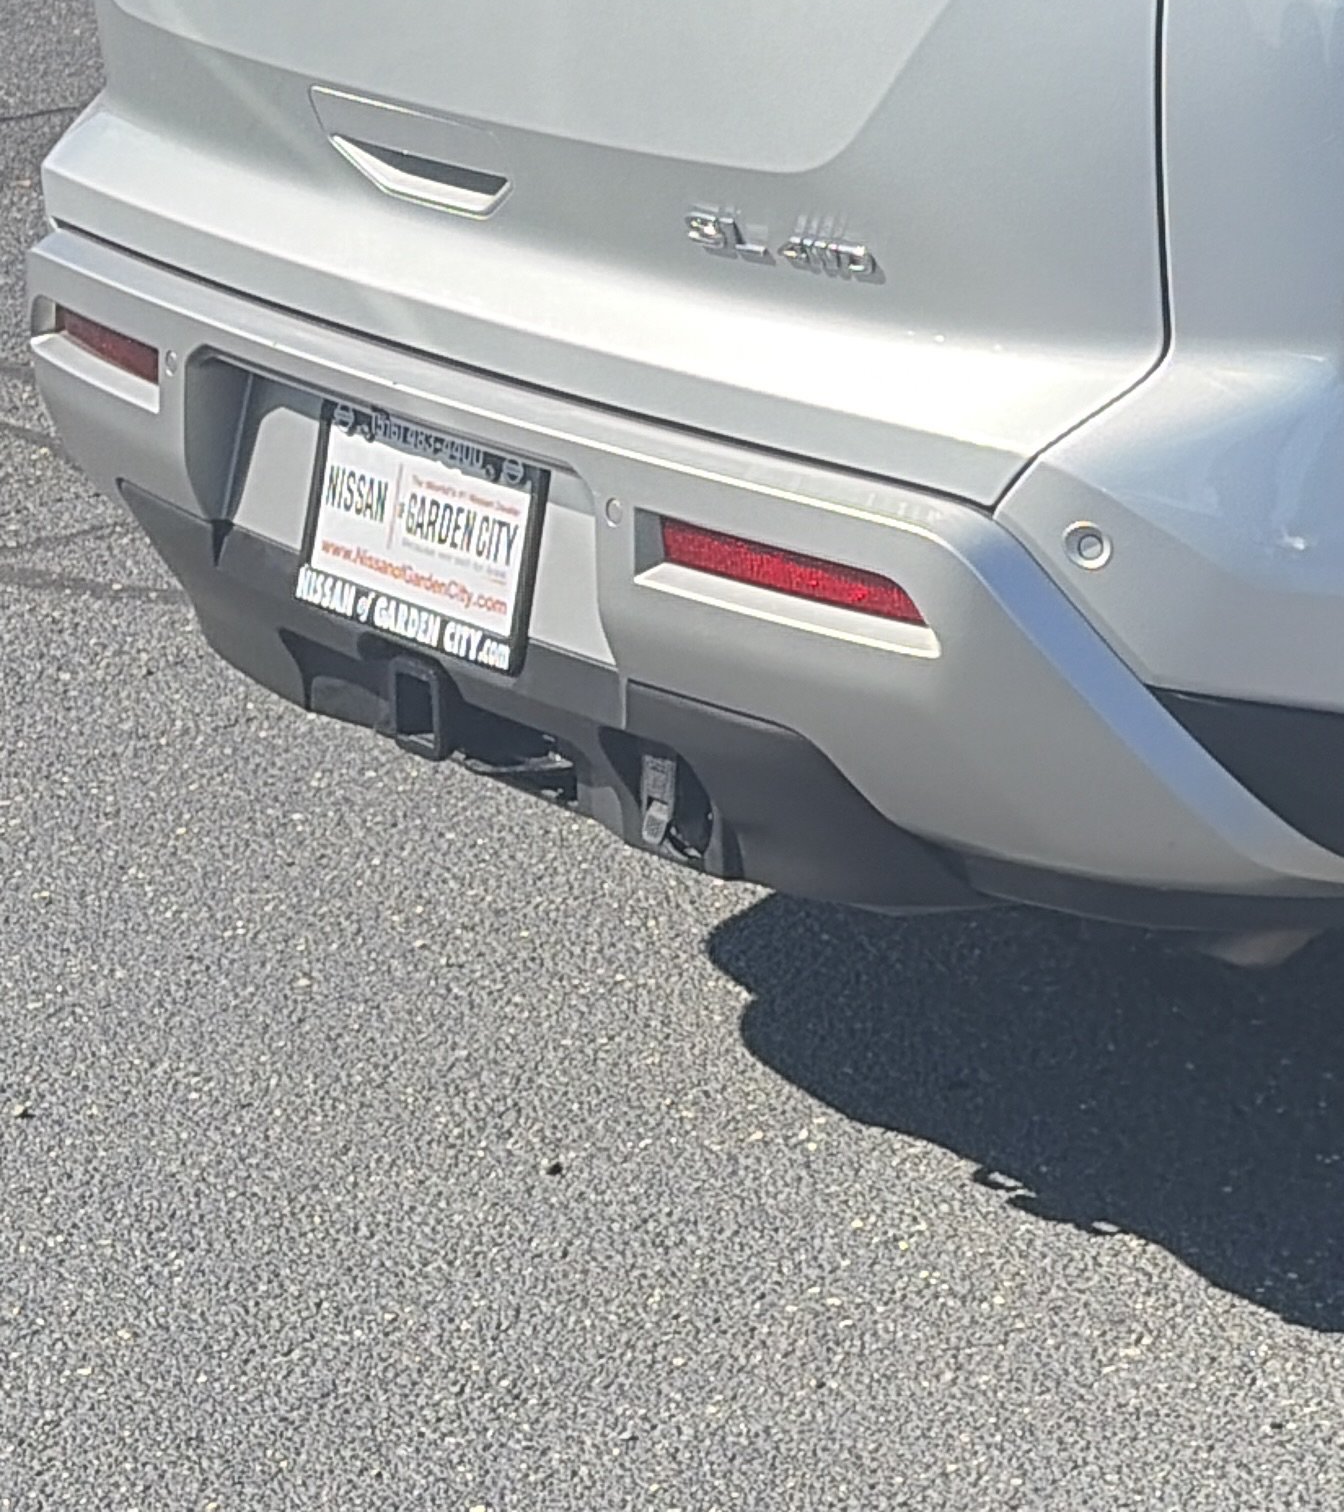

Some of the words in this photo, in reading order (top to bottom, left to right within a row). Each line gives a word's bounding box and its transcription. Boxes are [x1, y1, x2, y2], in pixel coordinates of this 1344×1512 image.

[684, 210, 769, 256] SL
[777, 236, 877, 276] 4WD
[326, 465, 388, 523] NISSAN
[405, 492, 477, 553] GARDEN
[476, 515, 519, 567] CITY
[295, 564, 356, 617] NISSAN
[356, 591, 376, 623] of
[374, 596, 440, 648] GARDEN
[443, 620, 510, 671] CITY.com
